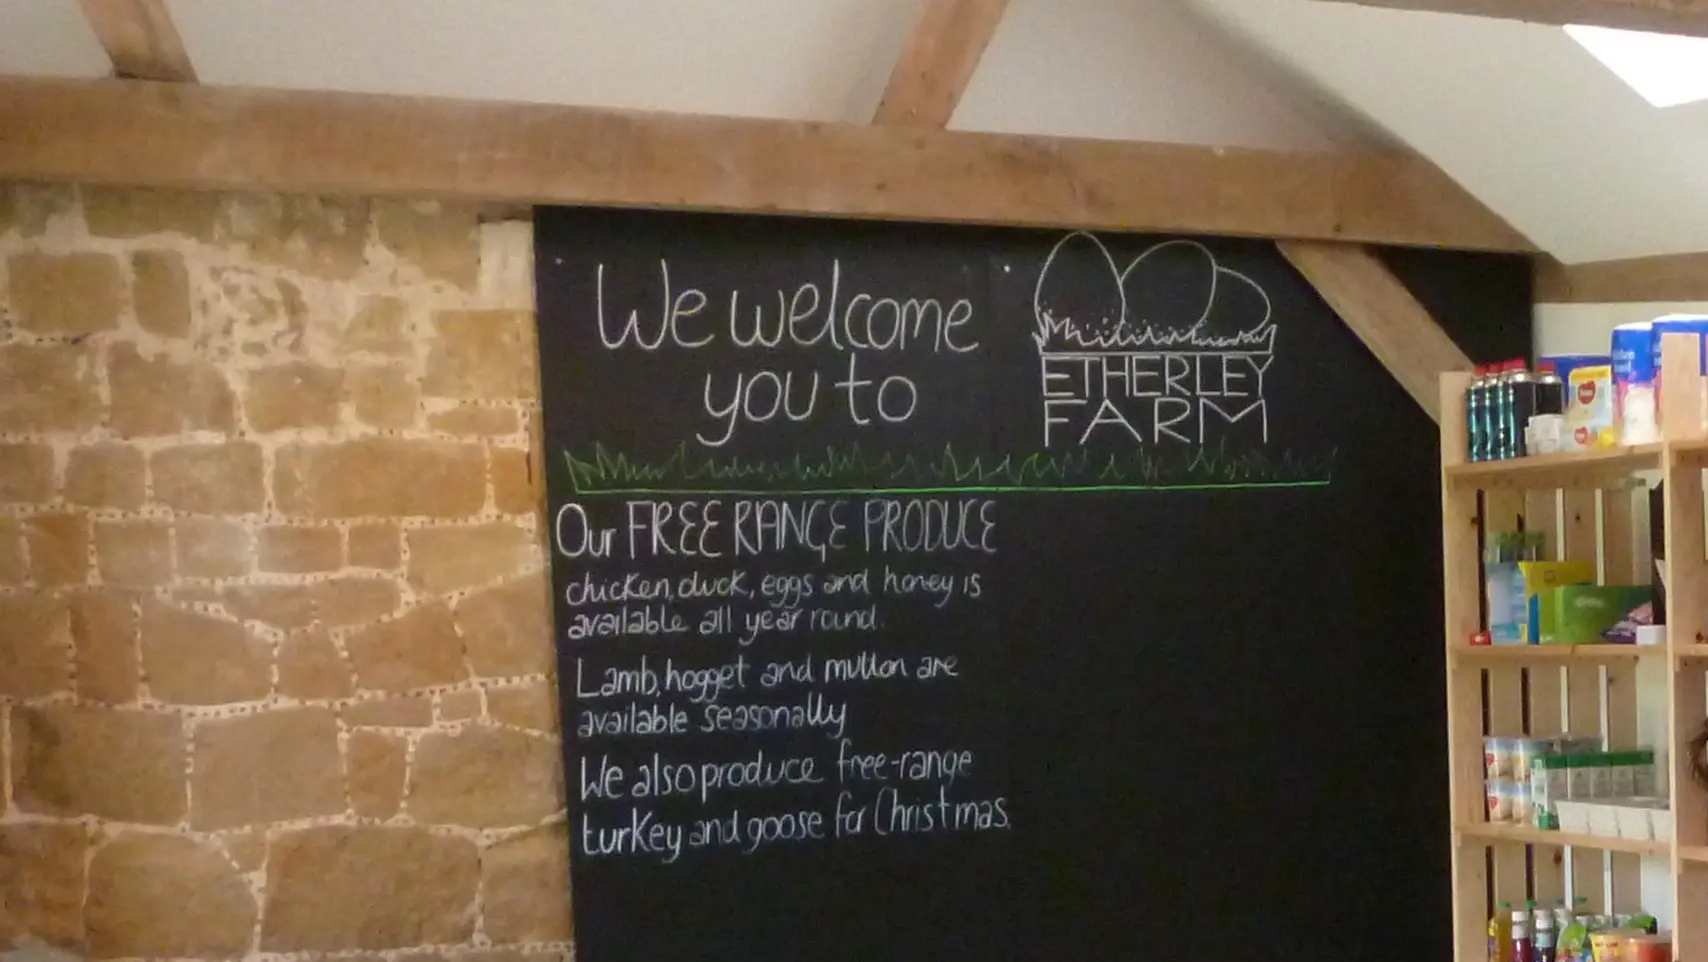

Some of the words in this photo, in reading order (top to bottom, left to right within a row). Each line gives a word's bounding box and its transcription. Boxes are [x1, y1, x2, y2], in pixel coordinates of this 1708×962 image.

[595, 258, 716, 352] We
[730, 258, 981, 354] welcome
[696, 371, 818, 446] you
[834, 351, 918, 425] to
[1040, 354, 1274, 398] ETHERLEY
[1042, 396, 1269, 448] FARM
[556, 502, 615, 558] Our
[627, 499, 724, 560] FREE
[734, 499, 850, 563] RANGE
[863, 498, 999, 554] PRODUCE
[677, 569, 755, 600] duck,
[761, 572, 814, 610] eggs
[823, 570, 869, 601] and
[884, 565, 954, 608] honey
[963, 573, 983, 599] is
[568, 605, 688, 640] available
[699, 604, 734, 634] all
[738, 609, 801, 645] year
[665, 655, 748, 703] hogget
[759, 654, 815, 686] and
[824, 651, 908, 683] mutton
[916, 656, 961, 679] are
[577, 702, 688, 738] available
[702, 692, 847, 739] seasonally
[581, 754, 625, 802] We
[632, 752, 697, 798] also
[700, 750, 824, 803] produce
[581, 808, 683, 864] turkey
[688, 809, 741, 847] and
[746, 810, 825, 854] goose
[834, 791, 866, 840] for
